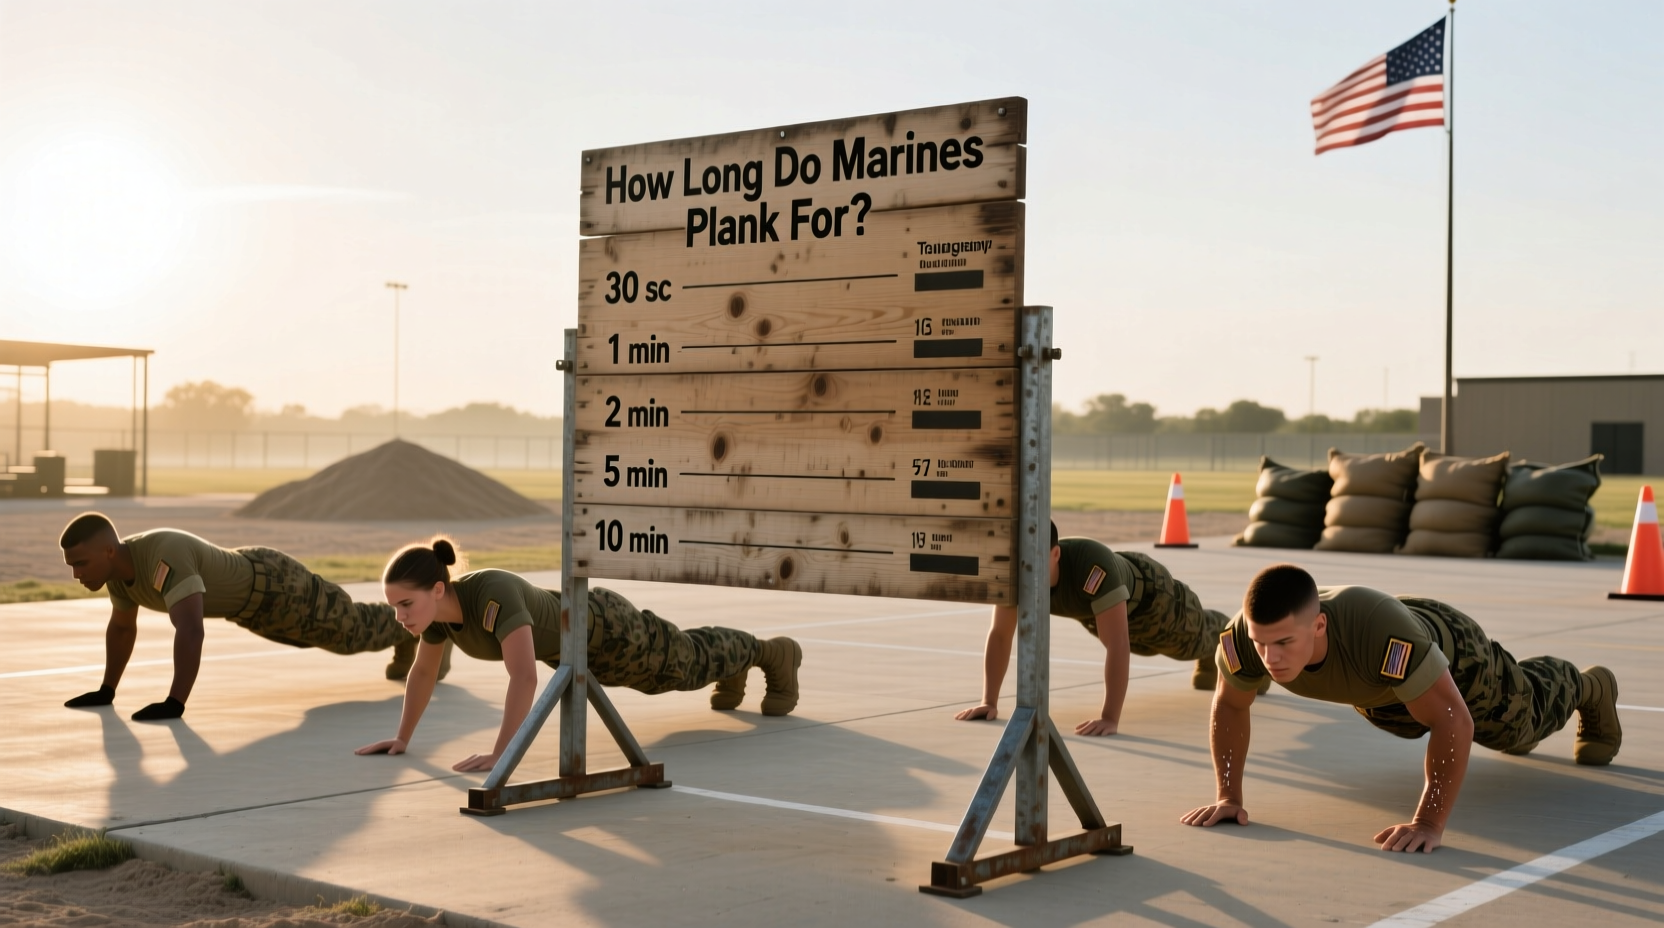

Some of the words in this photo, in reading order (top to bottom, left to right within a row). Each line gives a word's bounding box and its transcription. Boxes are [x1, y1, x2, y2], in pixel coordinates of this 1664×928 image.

[605, 165, 674, 205] How
[683, 158, 763, 202] Long
[774, 146, 822, 188] Do
[832, 130, 985, 182] Marines
[686, 201, 780, 248] Plank
[790, 192, 872, 241] For?
[605, 270, 639, 304] 30
[645, 279, 672, 302] sc
[608, 333, 619, 364] 1
[628, 334, 670, 364] min
[605, 395, 621, 427] 2
[628, 398, 669, 427] min
[603, 455, 620, 487] 5
[627, 458, 668, 488] min
[595, 519, 623, 552] 10
[629, 525, 669, 554] min
